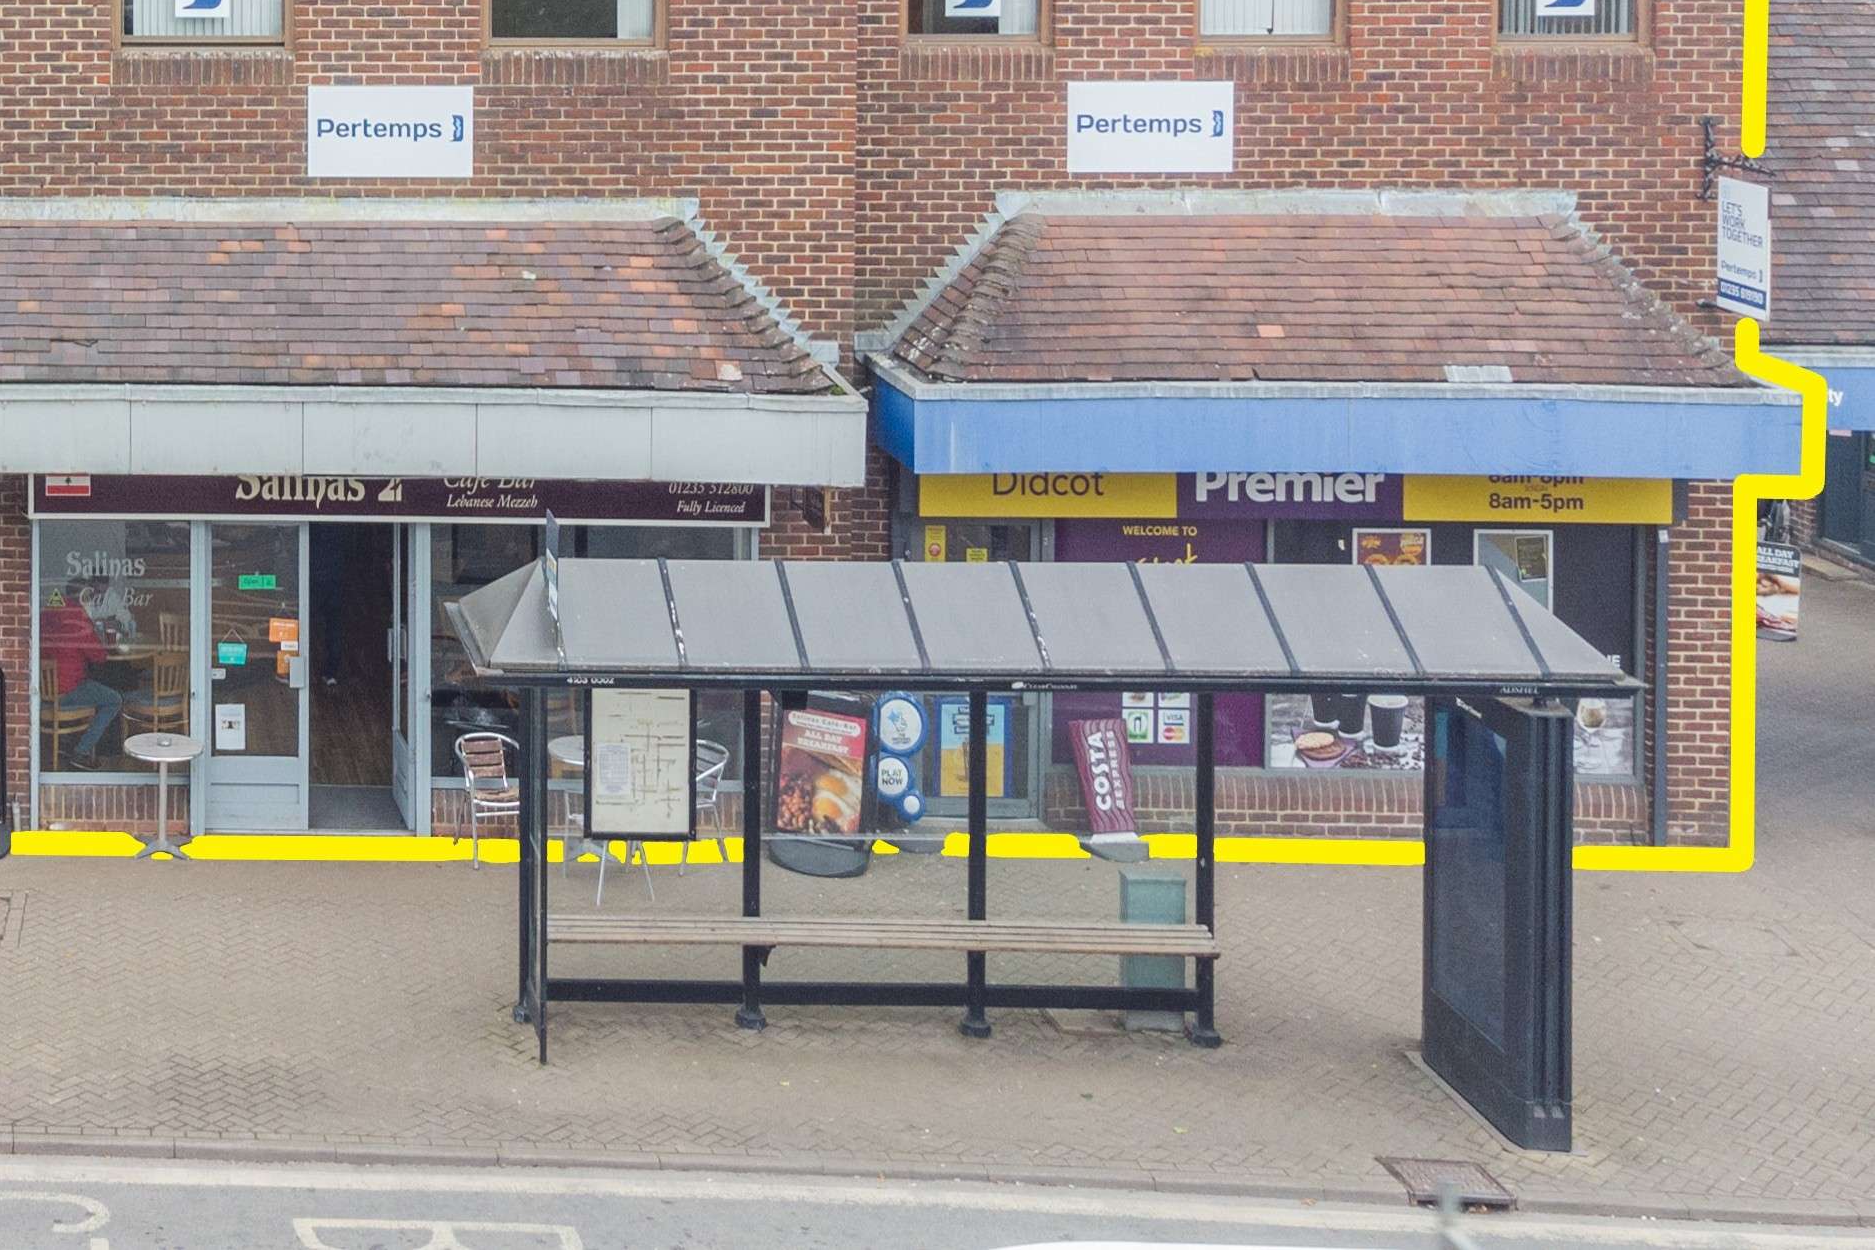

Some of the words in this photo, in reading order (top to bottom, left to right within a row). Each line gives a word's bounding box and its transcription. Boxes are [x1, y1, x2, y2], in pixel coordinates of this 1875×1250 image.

[316, 118, 442, 142] Pertemps
[1077, 114, 1202, 137] Pertemps
[1722, 213, 1745, 229] WORK
[1722, 226, 1763, 247] TOGETHER
[992, 472, 1104, 497] Didcot
[1195, 472, 1386, 503] Premier
[446, 494, 495, 508] Lebanese
[676, 500, 703, 514] Fully
[1488, 492, 1584, 513] 8am-5pm
[1122, 525, 1180, 537] WELCOME
[1181, 525, 1198, 537] TO
[66, 551, 146, 580] Salinas
[123, 587, 153, 607] Bar
[1166, 713, 1184, 721] VISA
[805, 729, 822, 741] ALL
[823, 732, 843, 745] DAY
[882, 769, 903, 779] PLAY
[1087, 731, 1112, 811] COSTA
[882, 778, 903, 786] NOW
